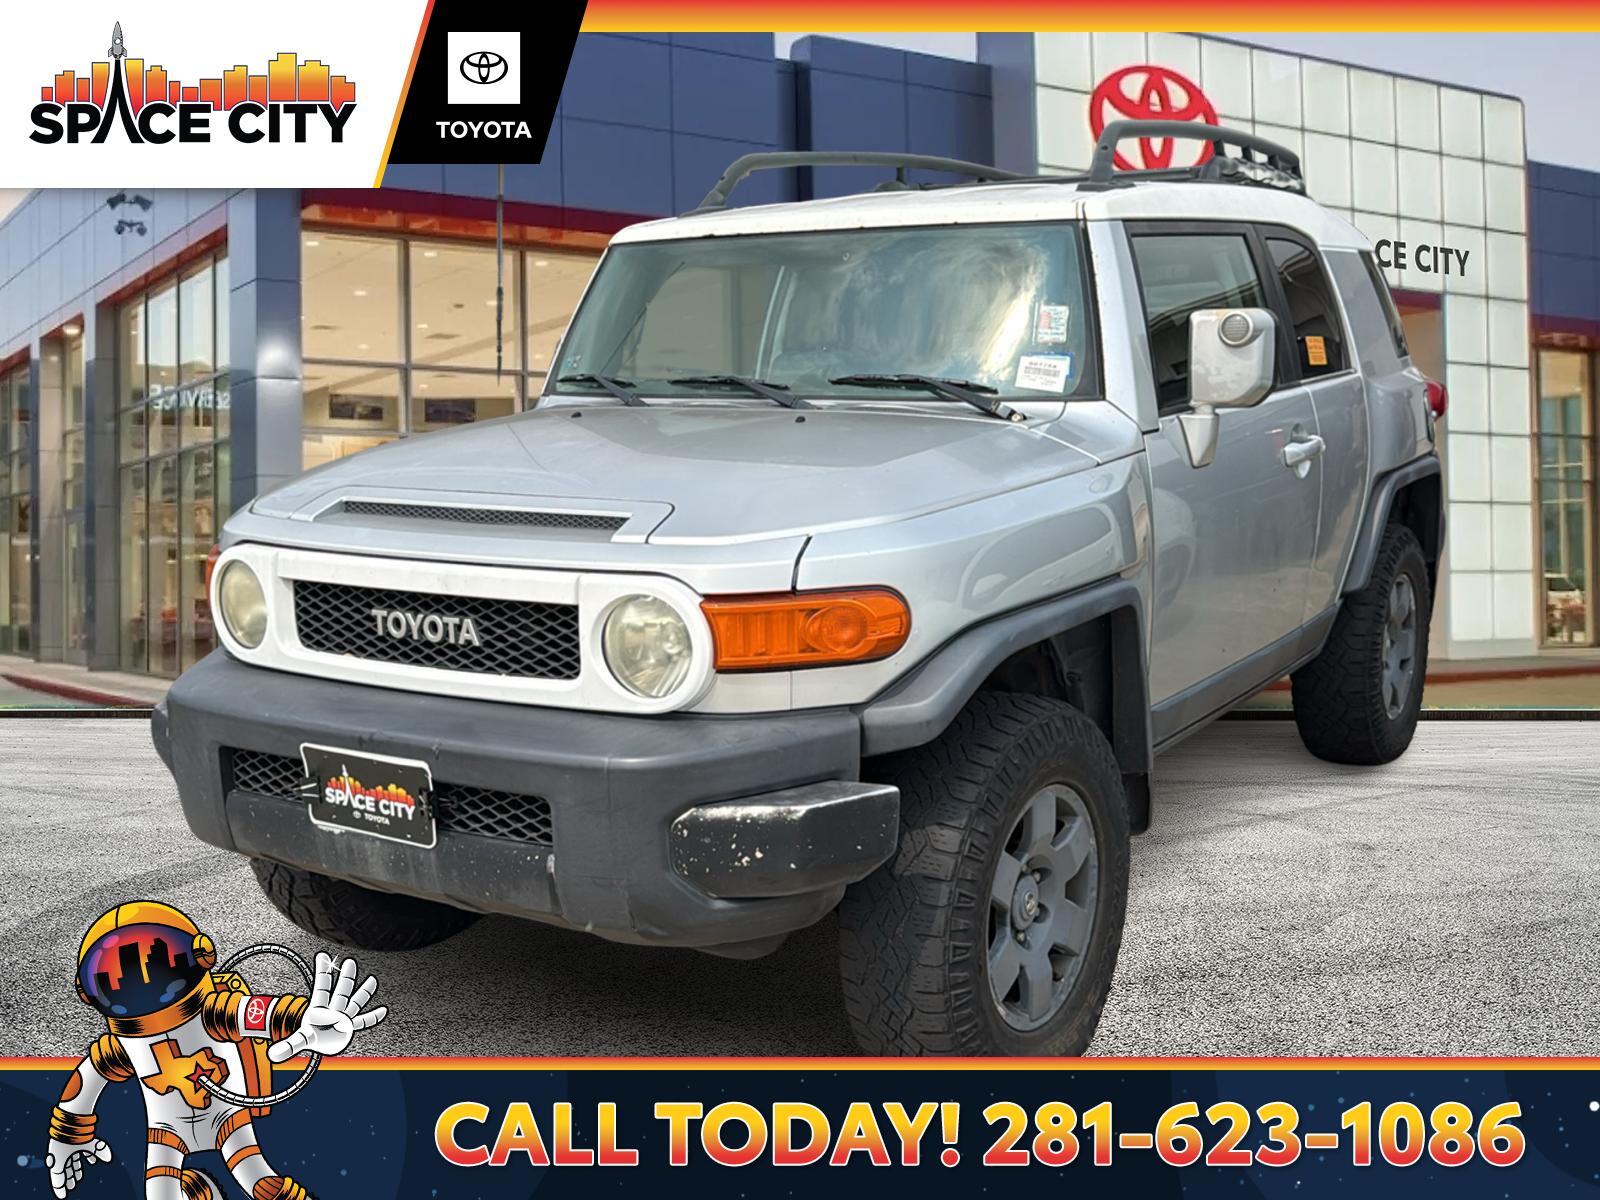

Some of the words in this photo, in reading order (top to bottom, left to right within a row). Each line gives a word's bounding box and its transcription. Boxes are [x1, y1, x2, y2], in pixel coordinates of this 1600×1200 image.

[1414, 244, 1470, 277] CITY
[370, 608, 480, 647] TOYOTA
[324, 781, 376, 813] SPACE
[378, 799, 416, 821] CITY
[363, 812, 391, 826] TOYOTA
